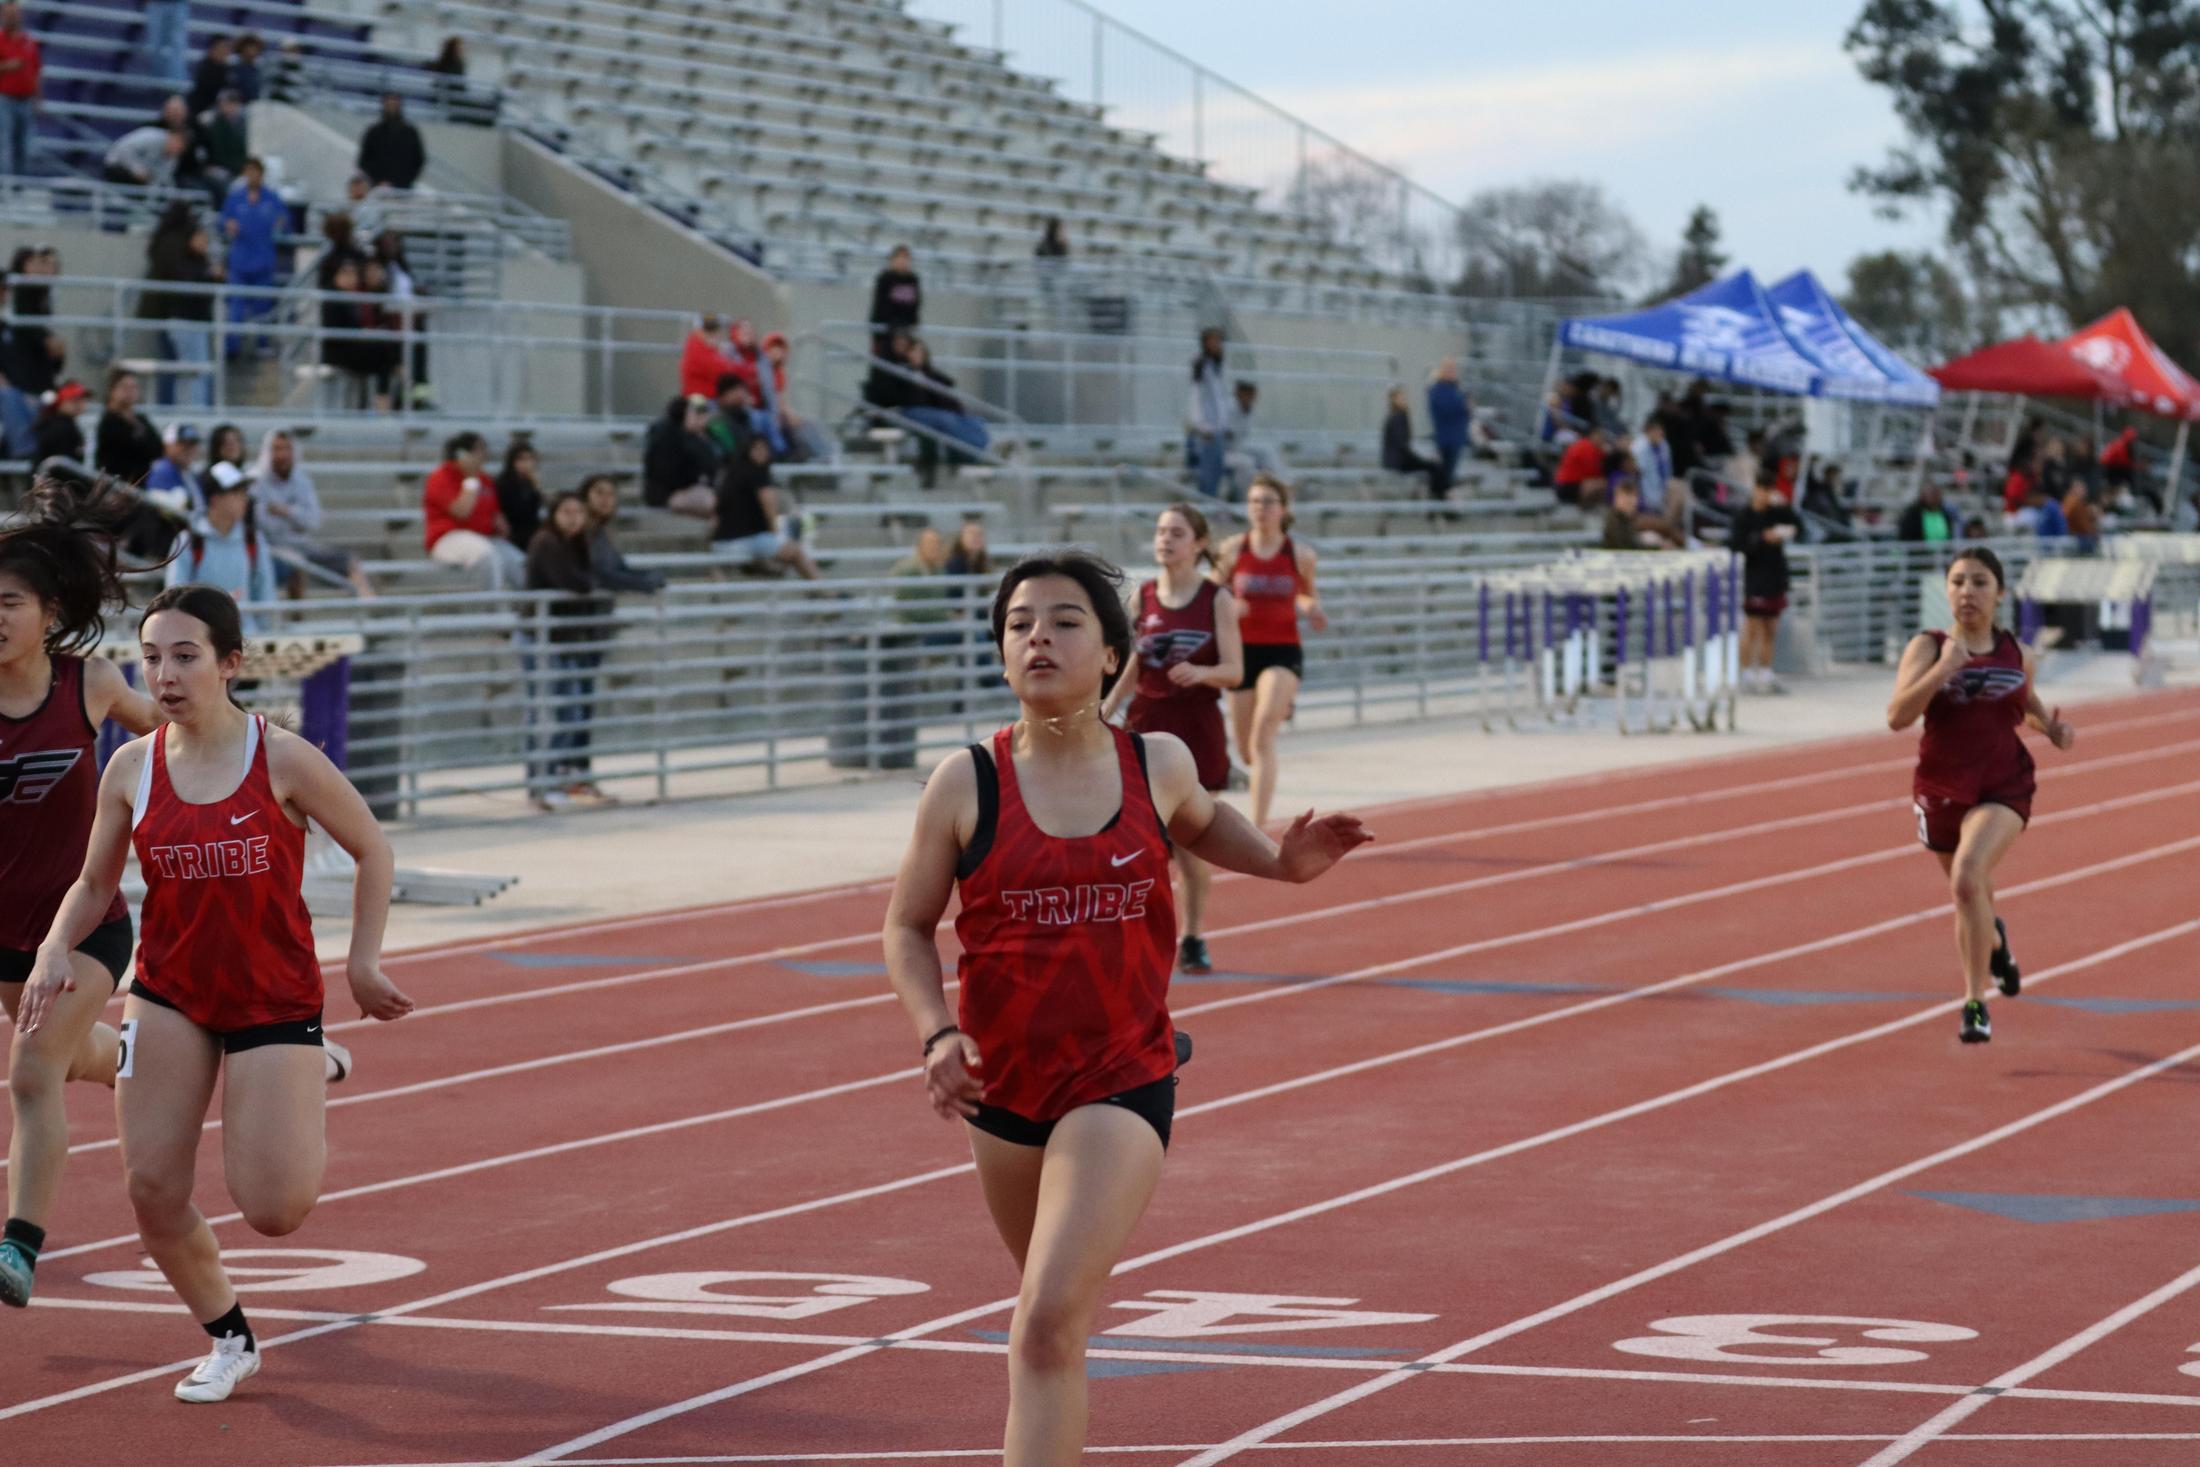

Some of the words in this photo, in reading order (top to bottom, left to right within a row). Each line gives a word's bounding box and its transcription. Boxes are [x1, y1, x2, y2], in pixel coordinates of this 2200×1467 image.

[150, 835, 270, 879] TRIBE
[1001, 878, 1155, 925] TRIBE
[539, 1271, 931, 1320] 5
[1100, 1290, 1440, 1337] 4
[1611, 1314, 1980, 1365] 3
